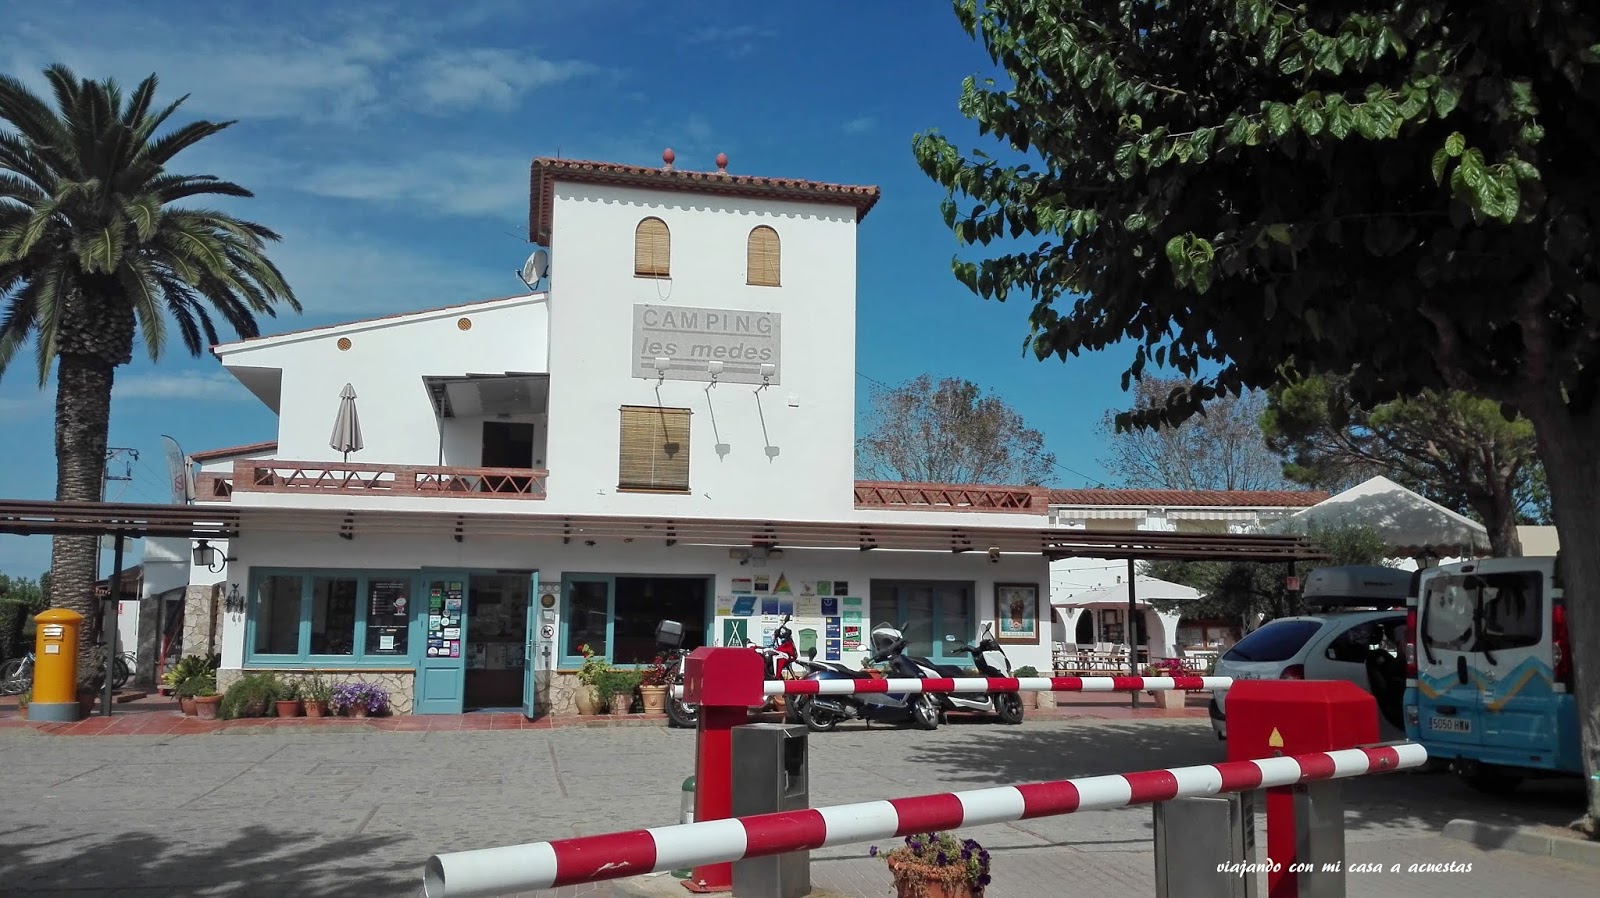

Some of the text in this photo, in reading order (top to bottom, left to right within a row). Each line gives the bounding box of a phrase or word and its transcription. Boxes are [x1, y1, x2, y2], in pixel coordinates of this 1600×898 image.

[642, 308, 772, 334] CAMPING
[641, 337, 772, 361] les medes
